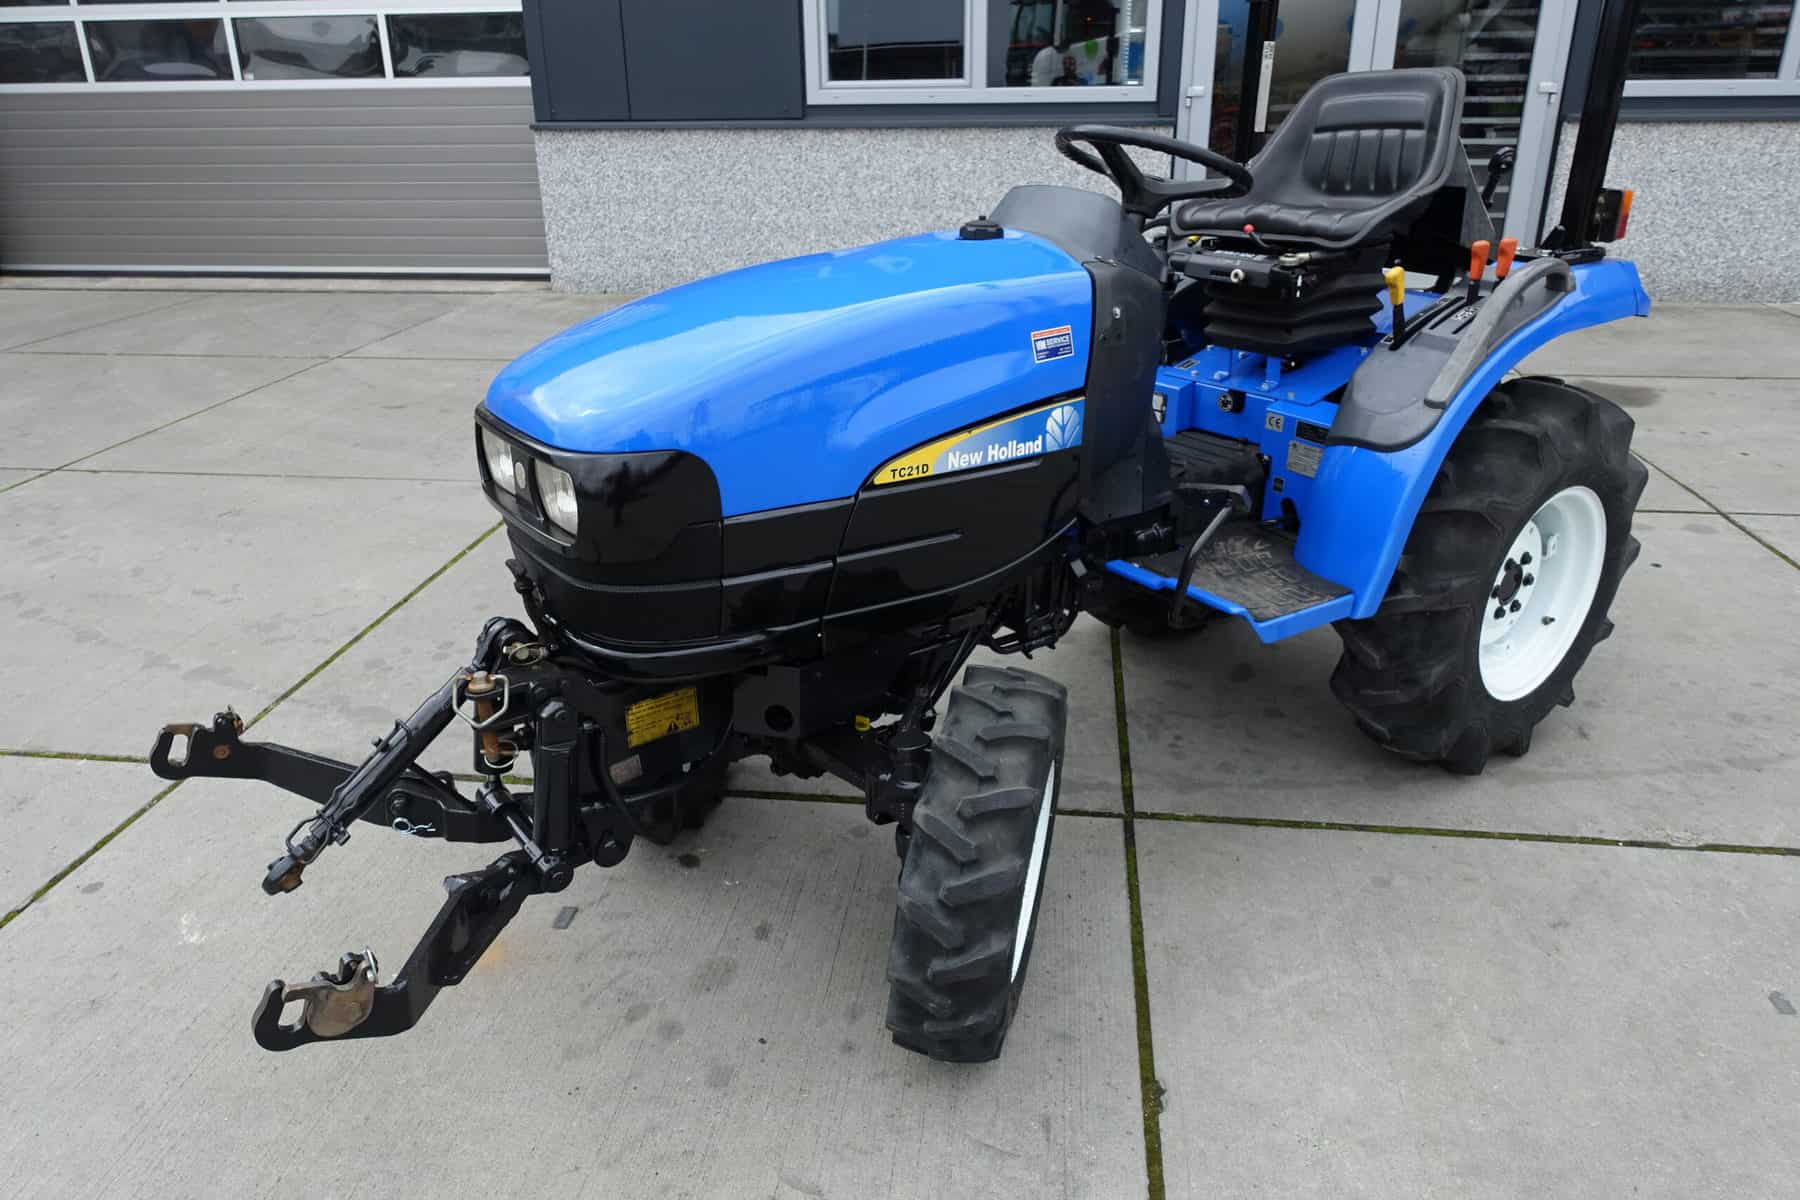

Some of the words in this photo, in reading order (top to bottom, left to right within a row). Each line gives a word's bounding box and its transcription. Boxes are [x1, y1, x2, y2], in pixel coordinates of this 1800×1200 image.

[948, 450, 983, 469] New
[987, 435, 1043, 461] Holland
[890, 463, 929, 479] TC21D
